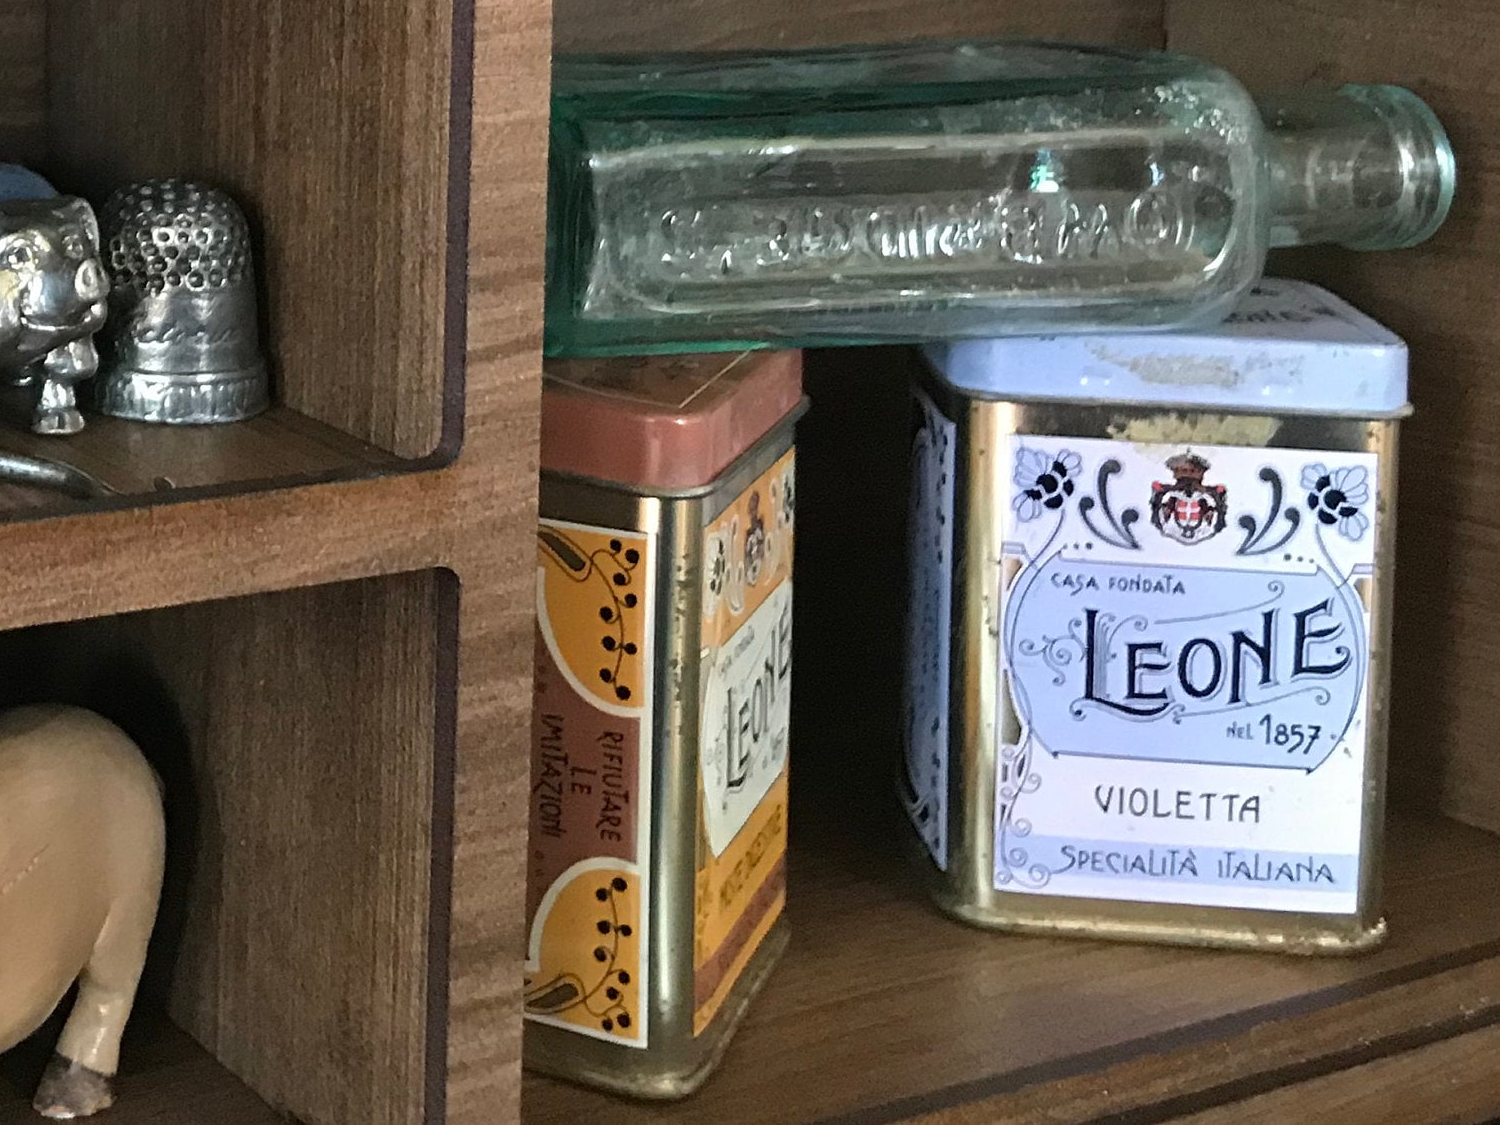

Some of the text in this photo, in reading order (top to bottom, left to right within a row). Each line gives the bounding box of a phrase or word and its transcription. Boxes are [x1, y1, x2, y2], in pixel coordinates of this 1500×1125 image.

[1051, 572, 1186, 596] CASA FONDATA
[1083, 598, 1351, 717] LEONE
[725, 605, 790, 789] LEONE
[1259, 714, 1322, 754] 1857
[570, 766, 597, 796] LE
[596, 731, 630, 842] RIFIUTARE
[1094, 784, 1262, 823] VIOLETTA
[1058, 844, 1336, 884] SPECIALITÀ ITALIANA
